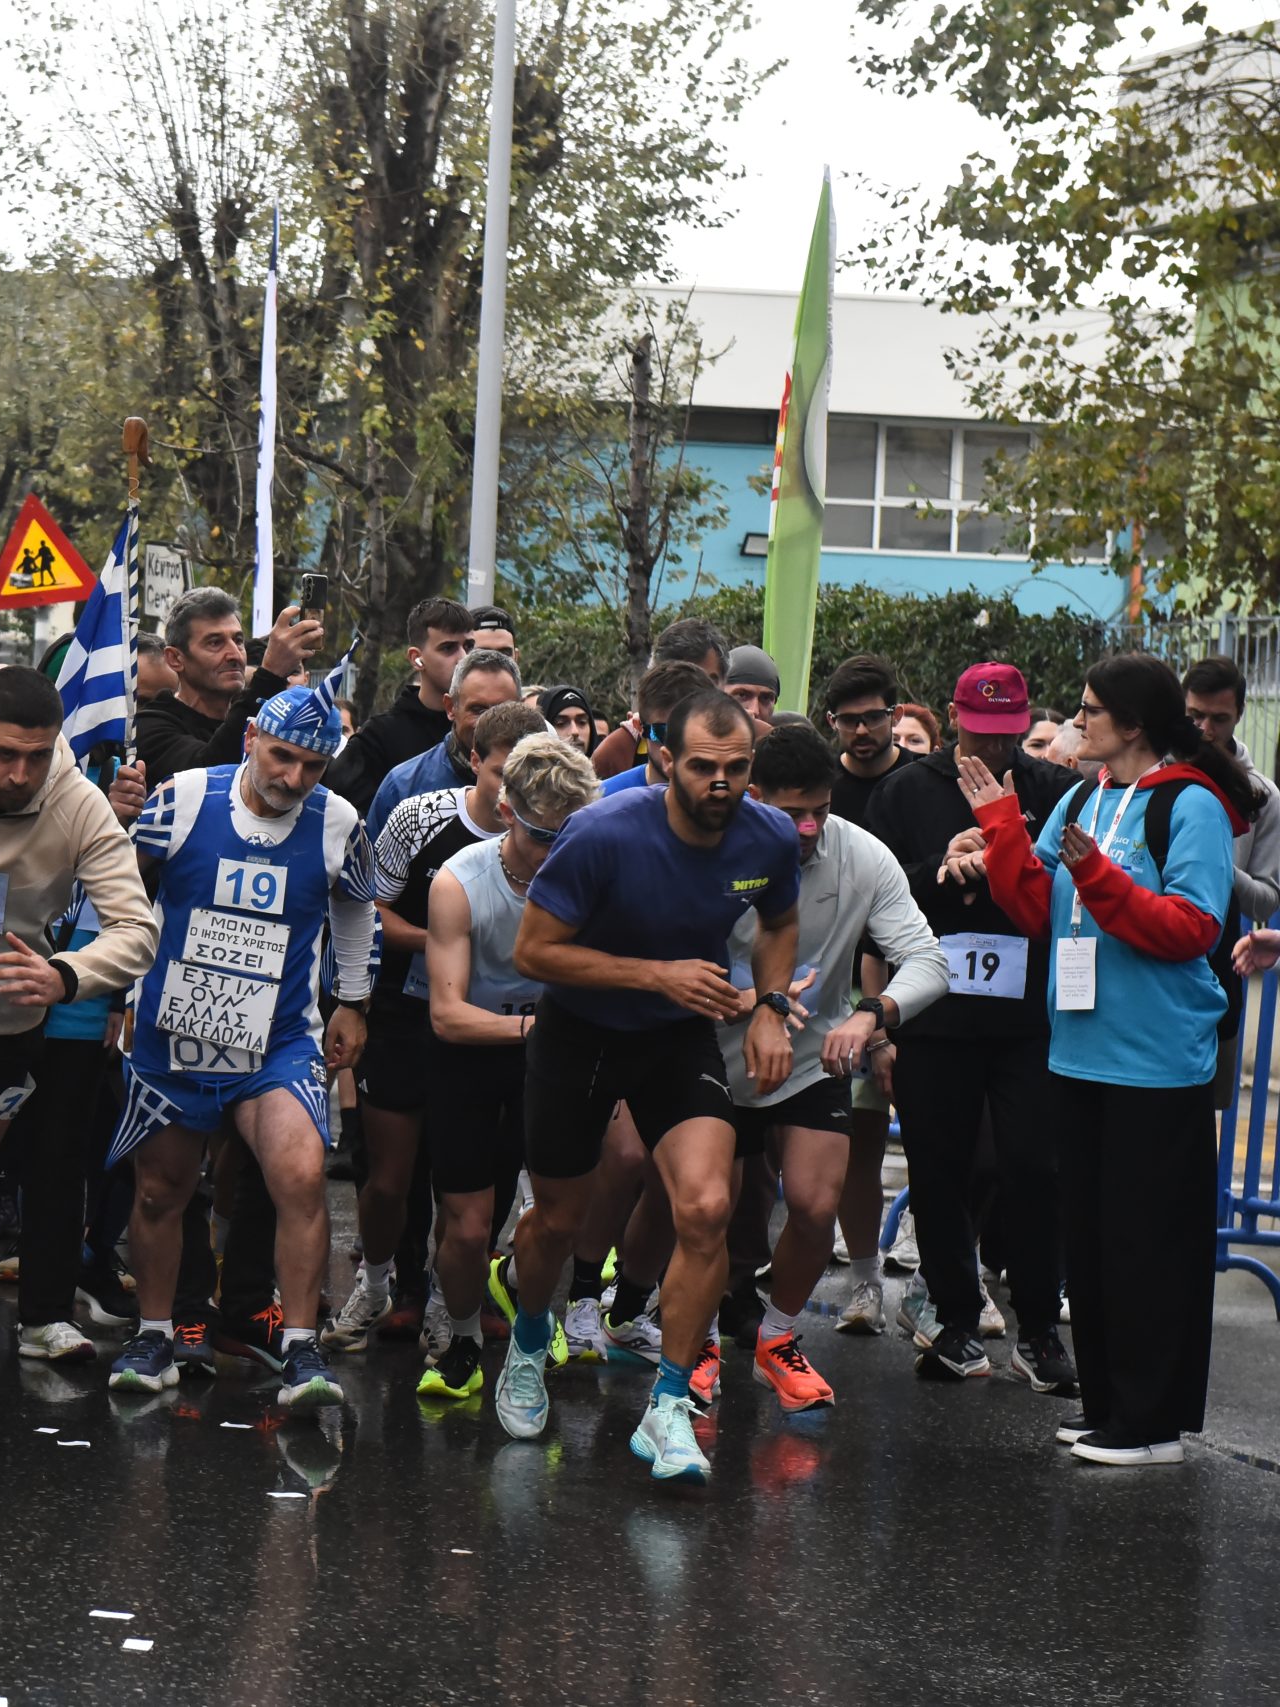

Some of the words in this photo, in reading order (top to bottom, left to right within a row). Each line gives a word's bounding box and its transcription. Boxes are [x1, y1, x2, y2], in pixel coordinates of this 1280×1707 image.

[226, 868, 277, 910] 19
[731, 877, 769, 890] NITRO
[189, 926, 198, 937] Ο
[200, 928, 240, 945] ΙΗΣΟΥΣ
[242, 937, 286, 954] ΧΡΙΣΤΟΣ
[210, 916, 266, 937] ΜΟΝΟ
[195, 943, 264, 969] ΣΩΖΕΙ
[965, 950, 1001, 982] 19
[182, 966, 266, 997] ΕΣΤΙΝ
[949, 972, 959, 980] m
[190, 986, 247, 1008] ΟΥΝ
[168, 996, 249, 1029] ΕΛΛΑΣ
[158, 1011, 264, 1052] ΜΑΚΕΔΟΝΙΑ
[173, 1036, 256, 1069] ΟΧΙ
